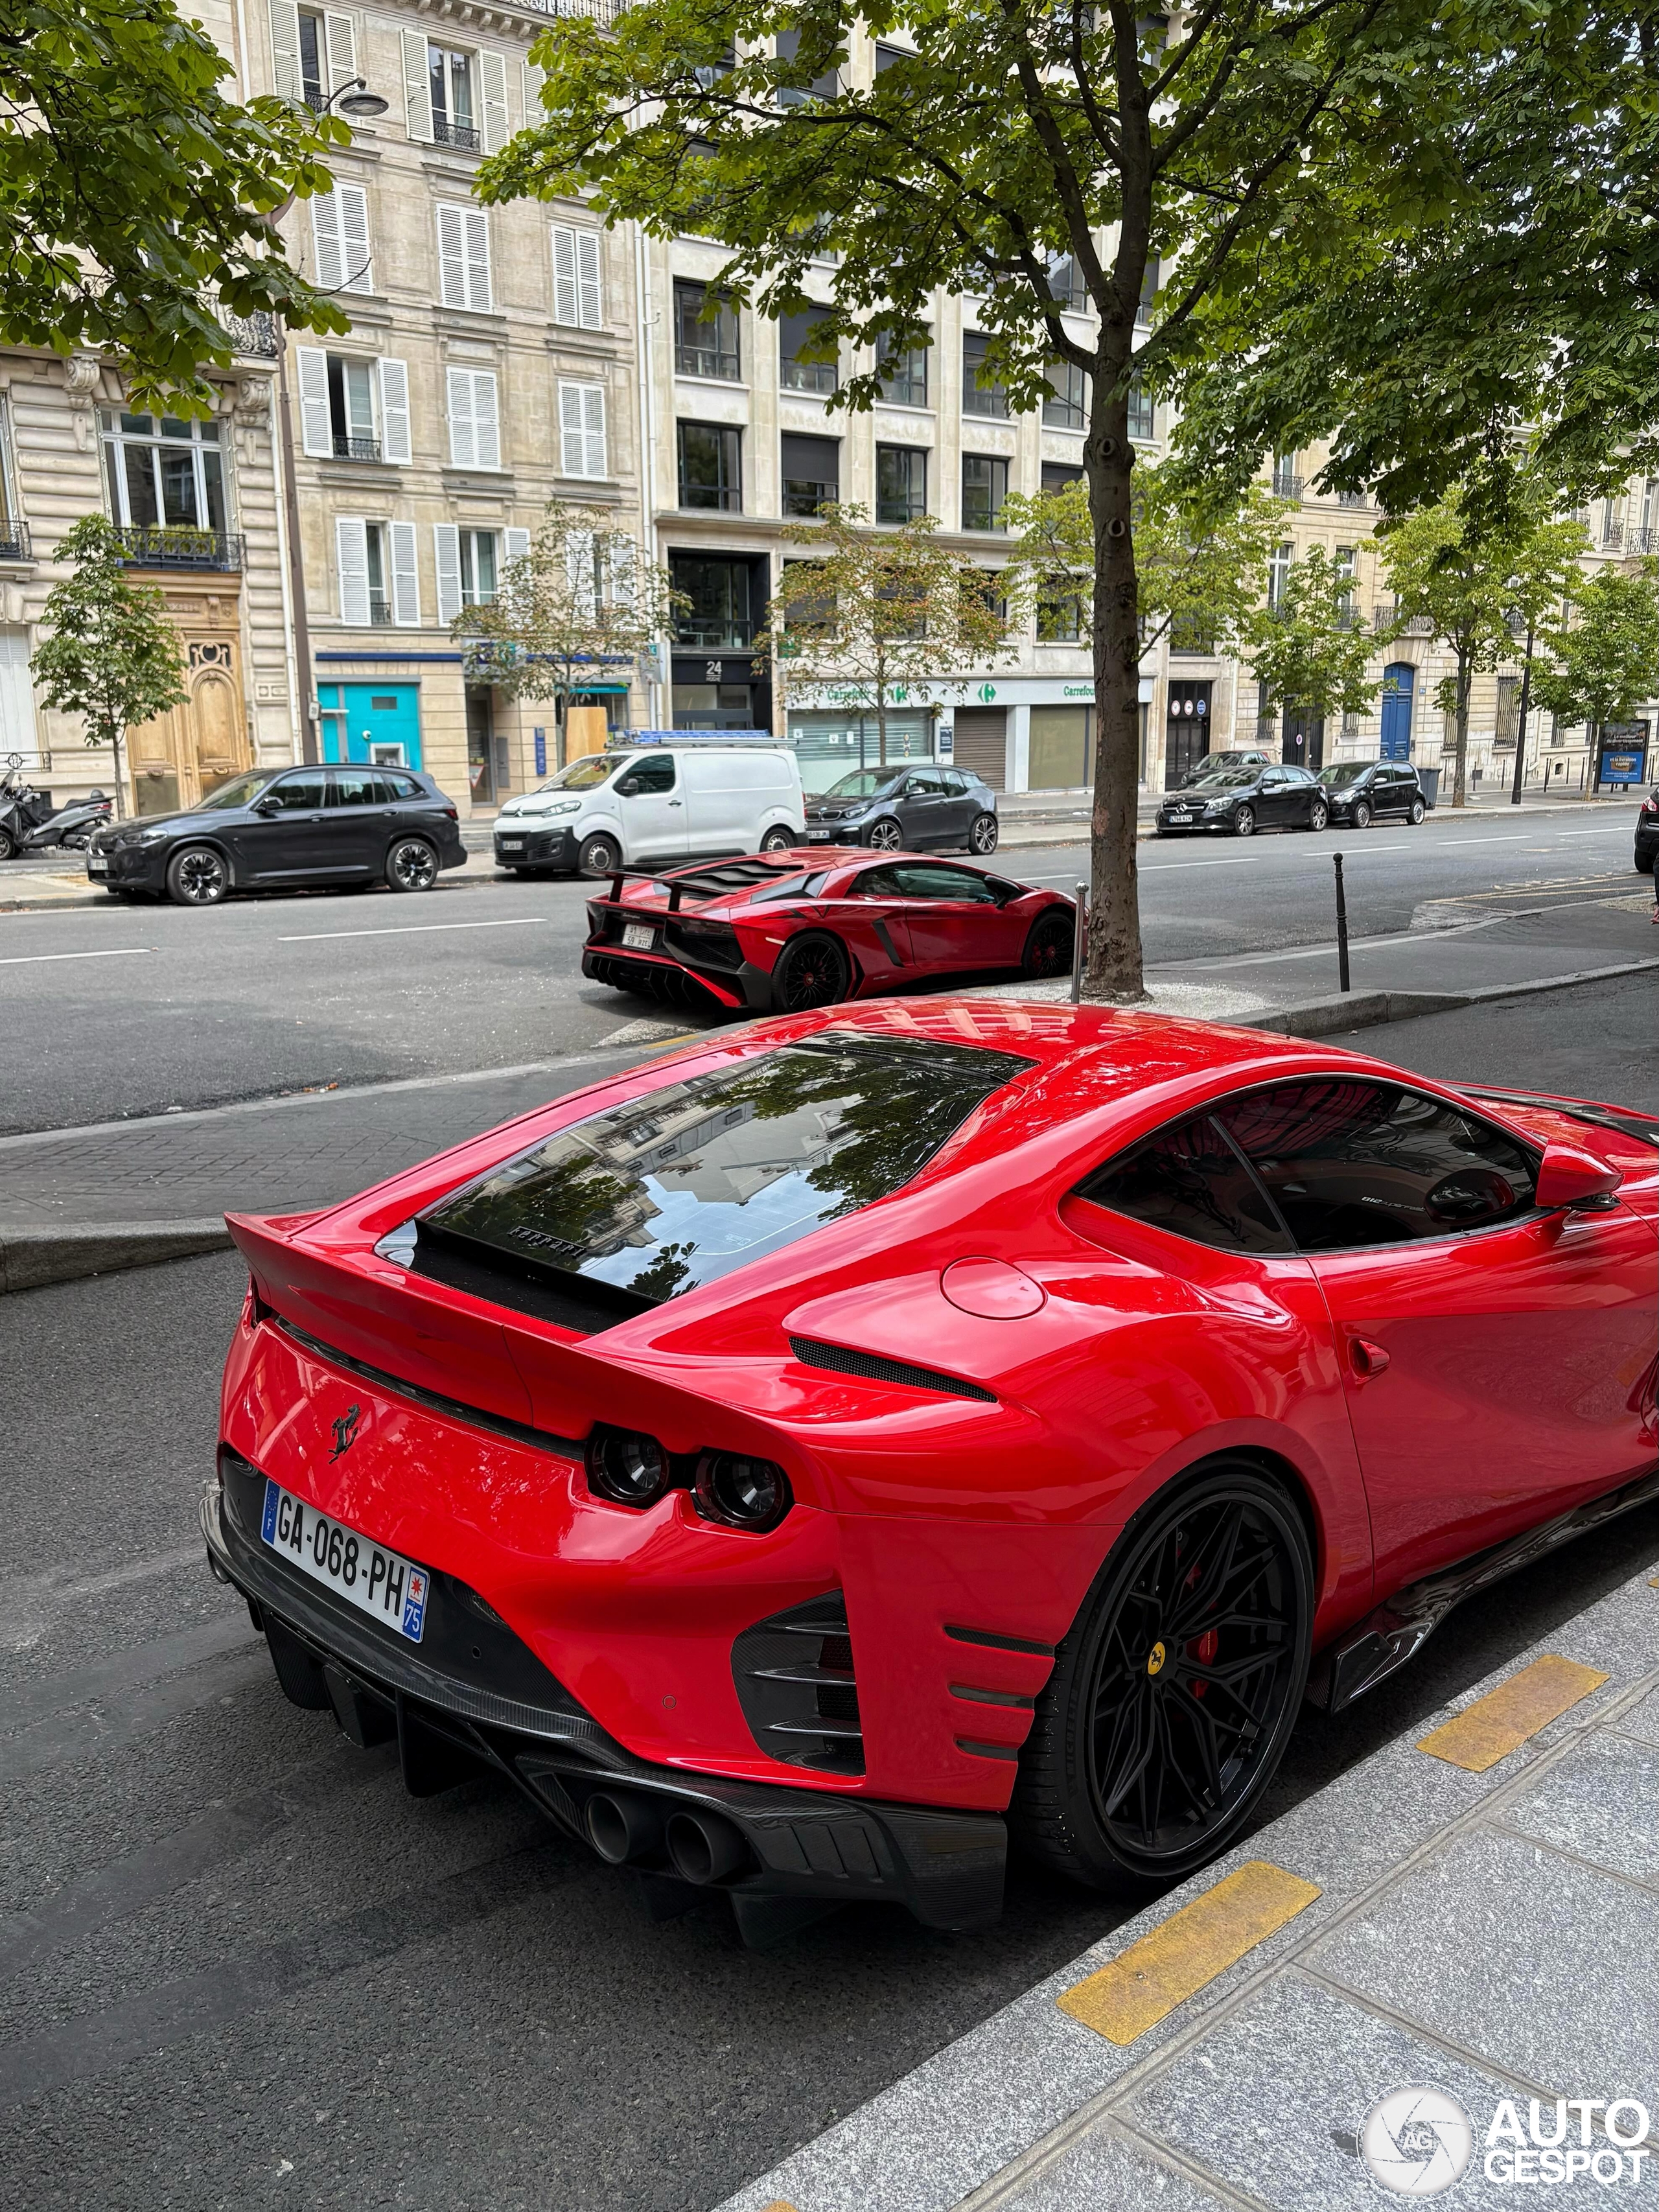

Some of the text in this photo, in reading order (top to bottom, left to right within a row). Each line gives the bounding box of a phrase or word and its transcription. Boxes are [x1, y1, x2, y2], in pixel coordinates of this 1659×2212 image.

[706, 661, 722, 675] 24
[1063, 685, 1095, 696] Carrefou
[507, 1226, 586, 1257] Ferrari
[266, 1518, 272, 1530] F
[278, 1495, 404, 1617] GA-068-PH
[404, 1605, 421, 1633] 75
[1067, 1688, 1078, 1776] MICHELIN
